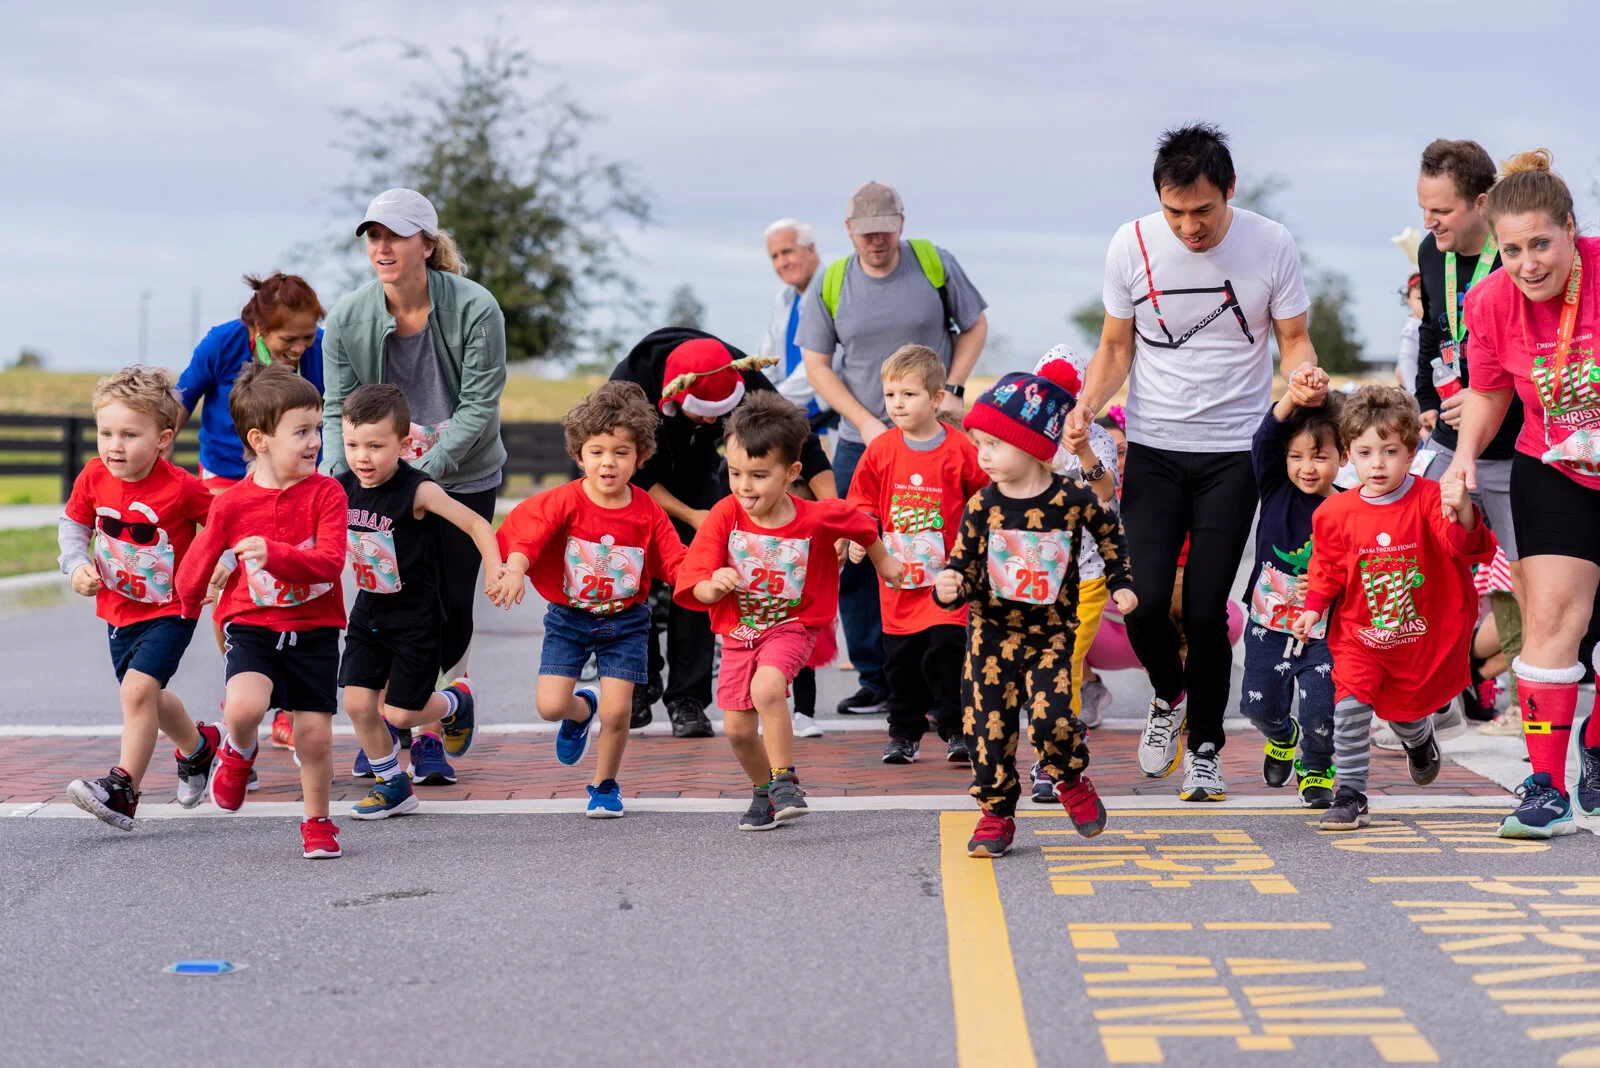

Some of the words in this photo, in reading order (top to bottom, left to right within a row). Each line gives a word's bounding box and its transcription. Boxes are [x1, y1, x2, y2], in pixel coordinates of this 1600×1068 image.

[1182, 306, 1223, 341] COLNAGO
[115, 569, 147, 599] 25
[352, 561, 377, 592] 25
[579, 574, 616, 602] 25
[749, 567, 787, 596] 25
[1015, 568, 1050, 601] 25
[273, 580, 311, 605] 25
[1270, 748, 1289, 759] NIKE
[1304, 777, 1324, 787] NIKE
[1035, 828, 1298, 896] FIRE
[1067, 921, 1441, 1064] LANE
